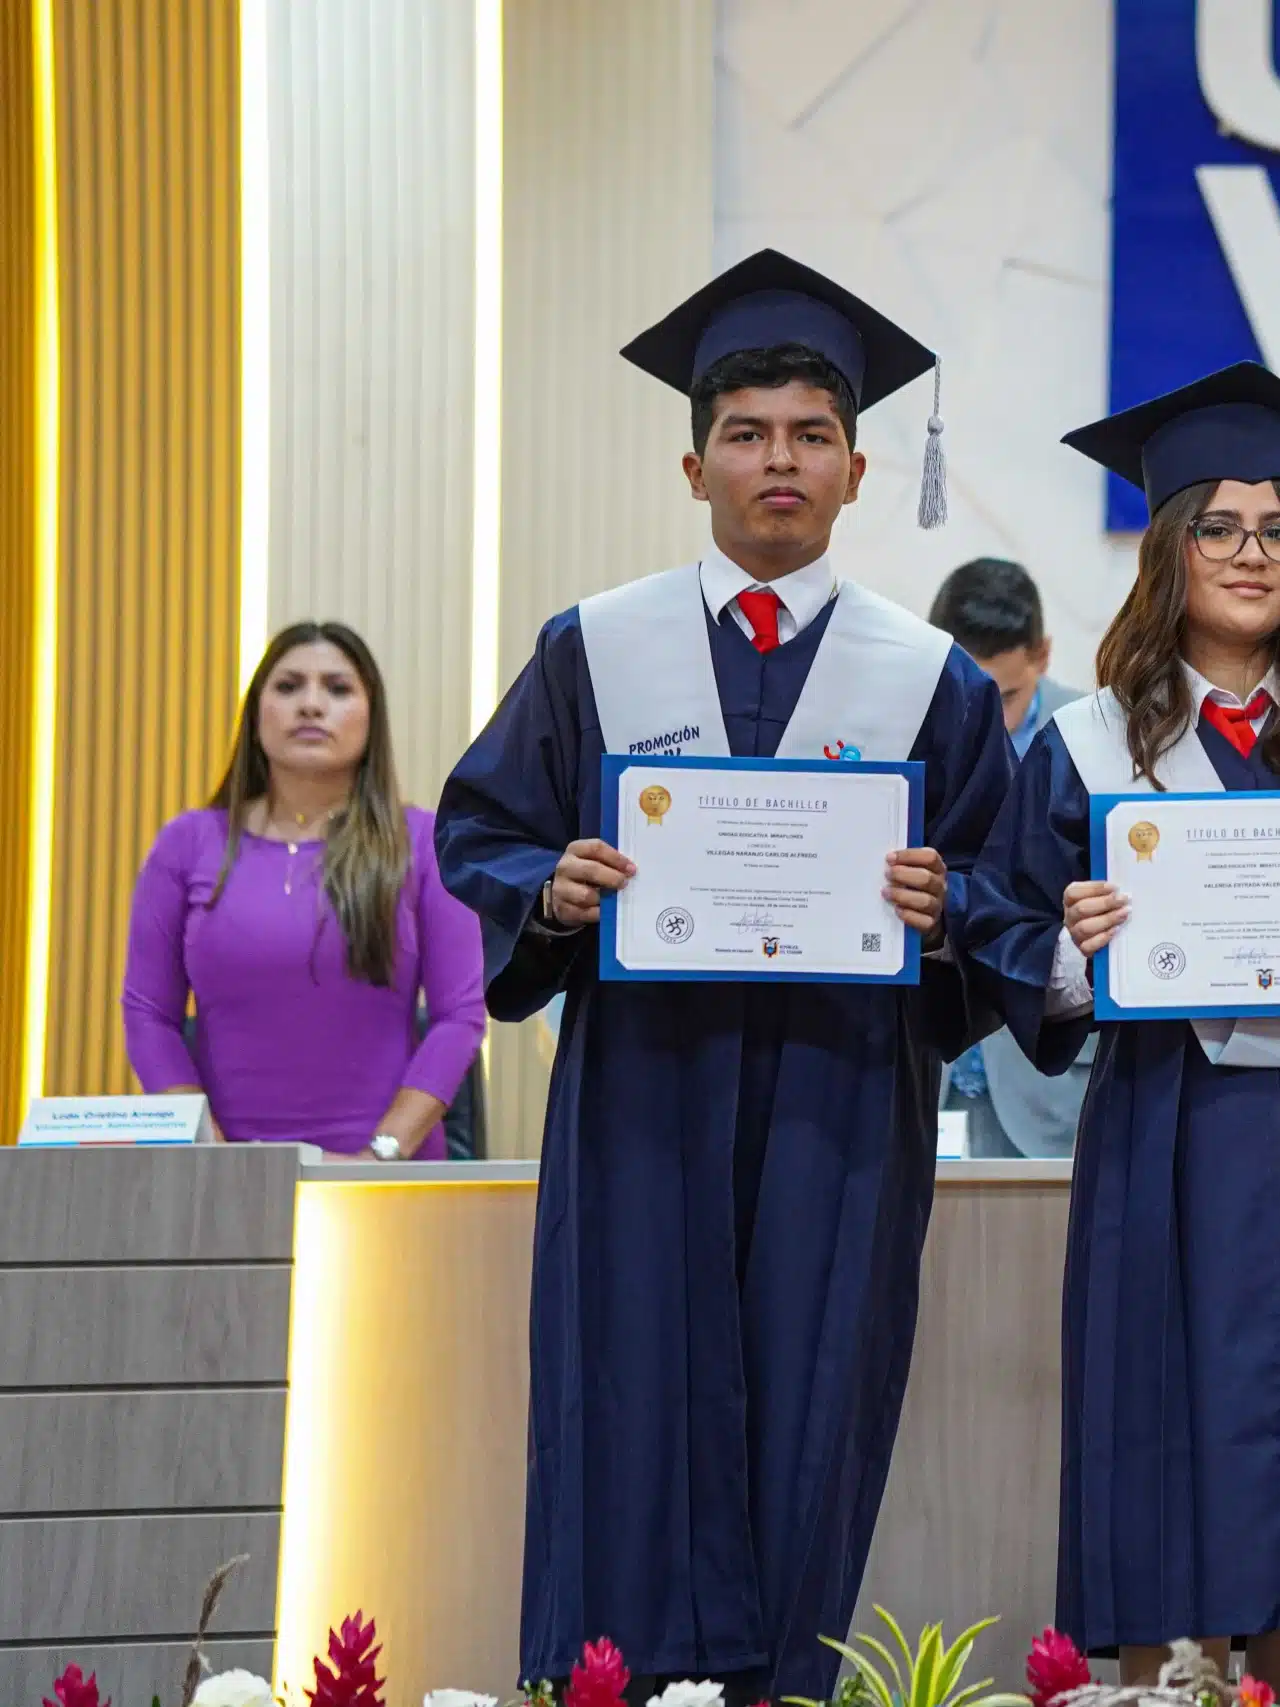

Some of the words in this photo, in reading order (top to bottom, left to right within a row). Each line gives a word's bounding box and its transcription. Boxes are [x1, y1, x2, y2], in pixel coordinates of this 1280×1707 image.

[629, 725, 700, 755] PROMOCIÓN
[699, 795, 739, 807] TÍTULO
[746, 798, 759, 808] DE
[766, 799, 828, 810] BACHILLER
[1186, 827, 1226, 839] TÍTULO
[1234, 828, 1246, 838] DE
